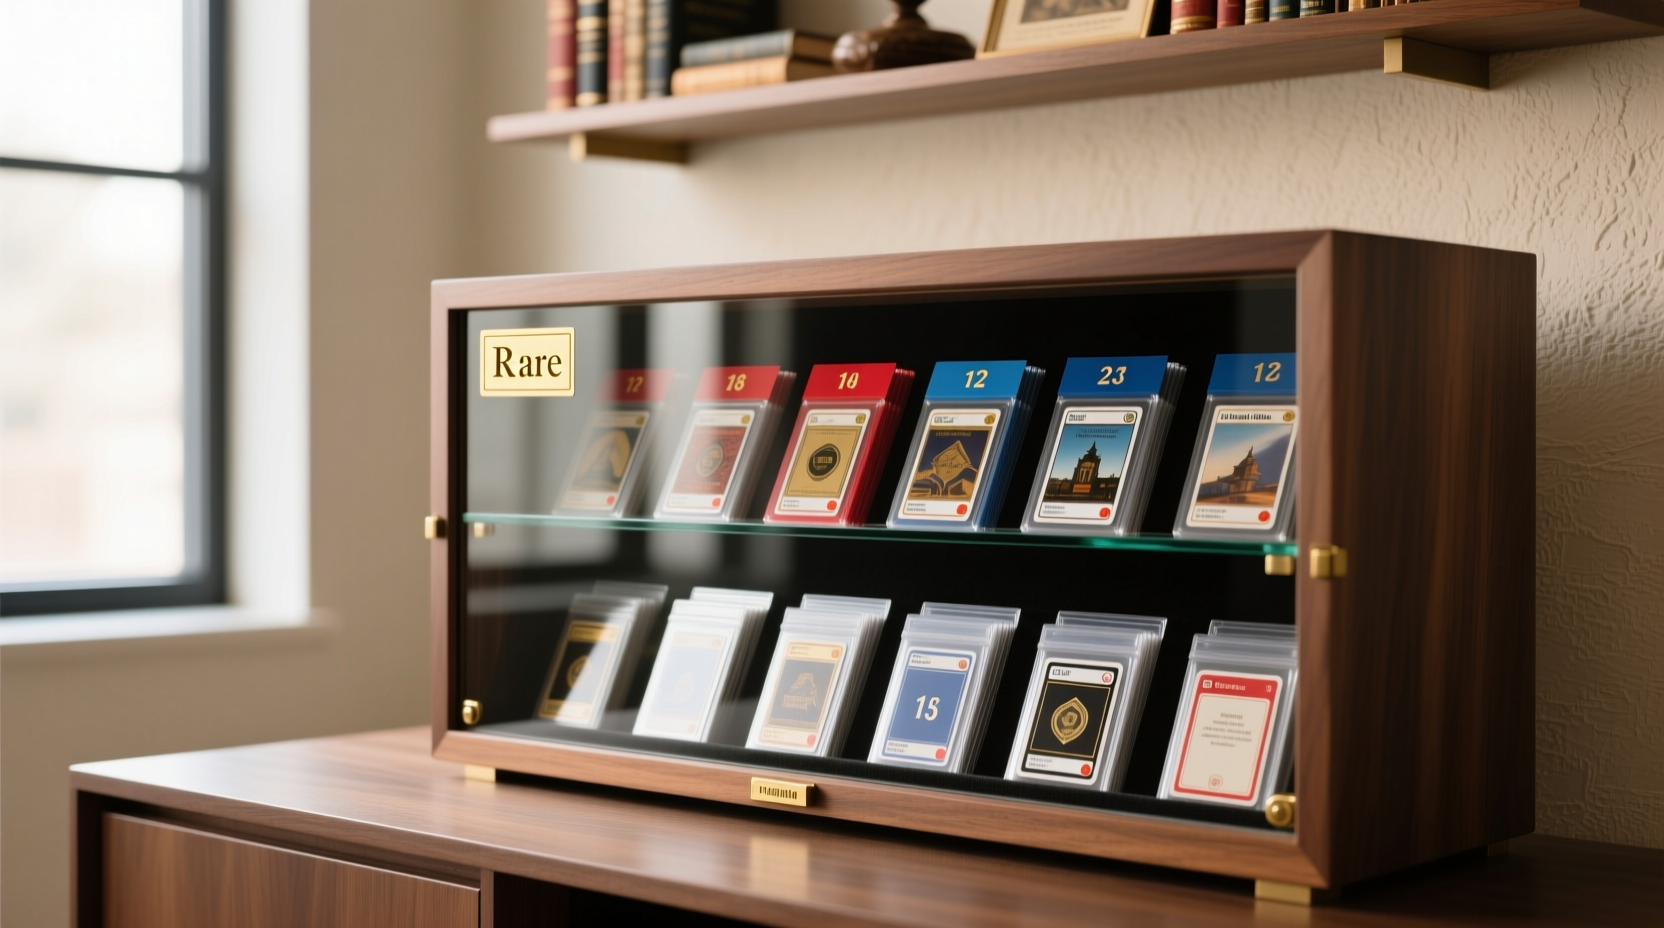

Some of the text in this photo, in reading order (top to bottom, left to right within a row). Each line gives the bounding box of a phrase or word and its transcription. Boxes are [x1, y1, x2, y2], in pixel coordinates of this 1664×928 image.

[492, 346, 562, 378] Rare
[1254, 361, 1282, 383] 12
[726, 373, 747, 391] 18
[965, 369, 989, 389] 12
[1097, 366, 1127, 386] 23
